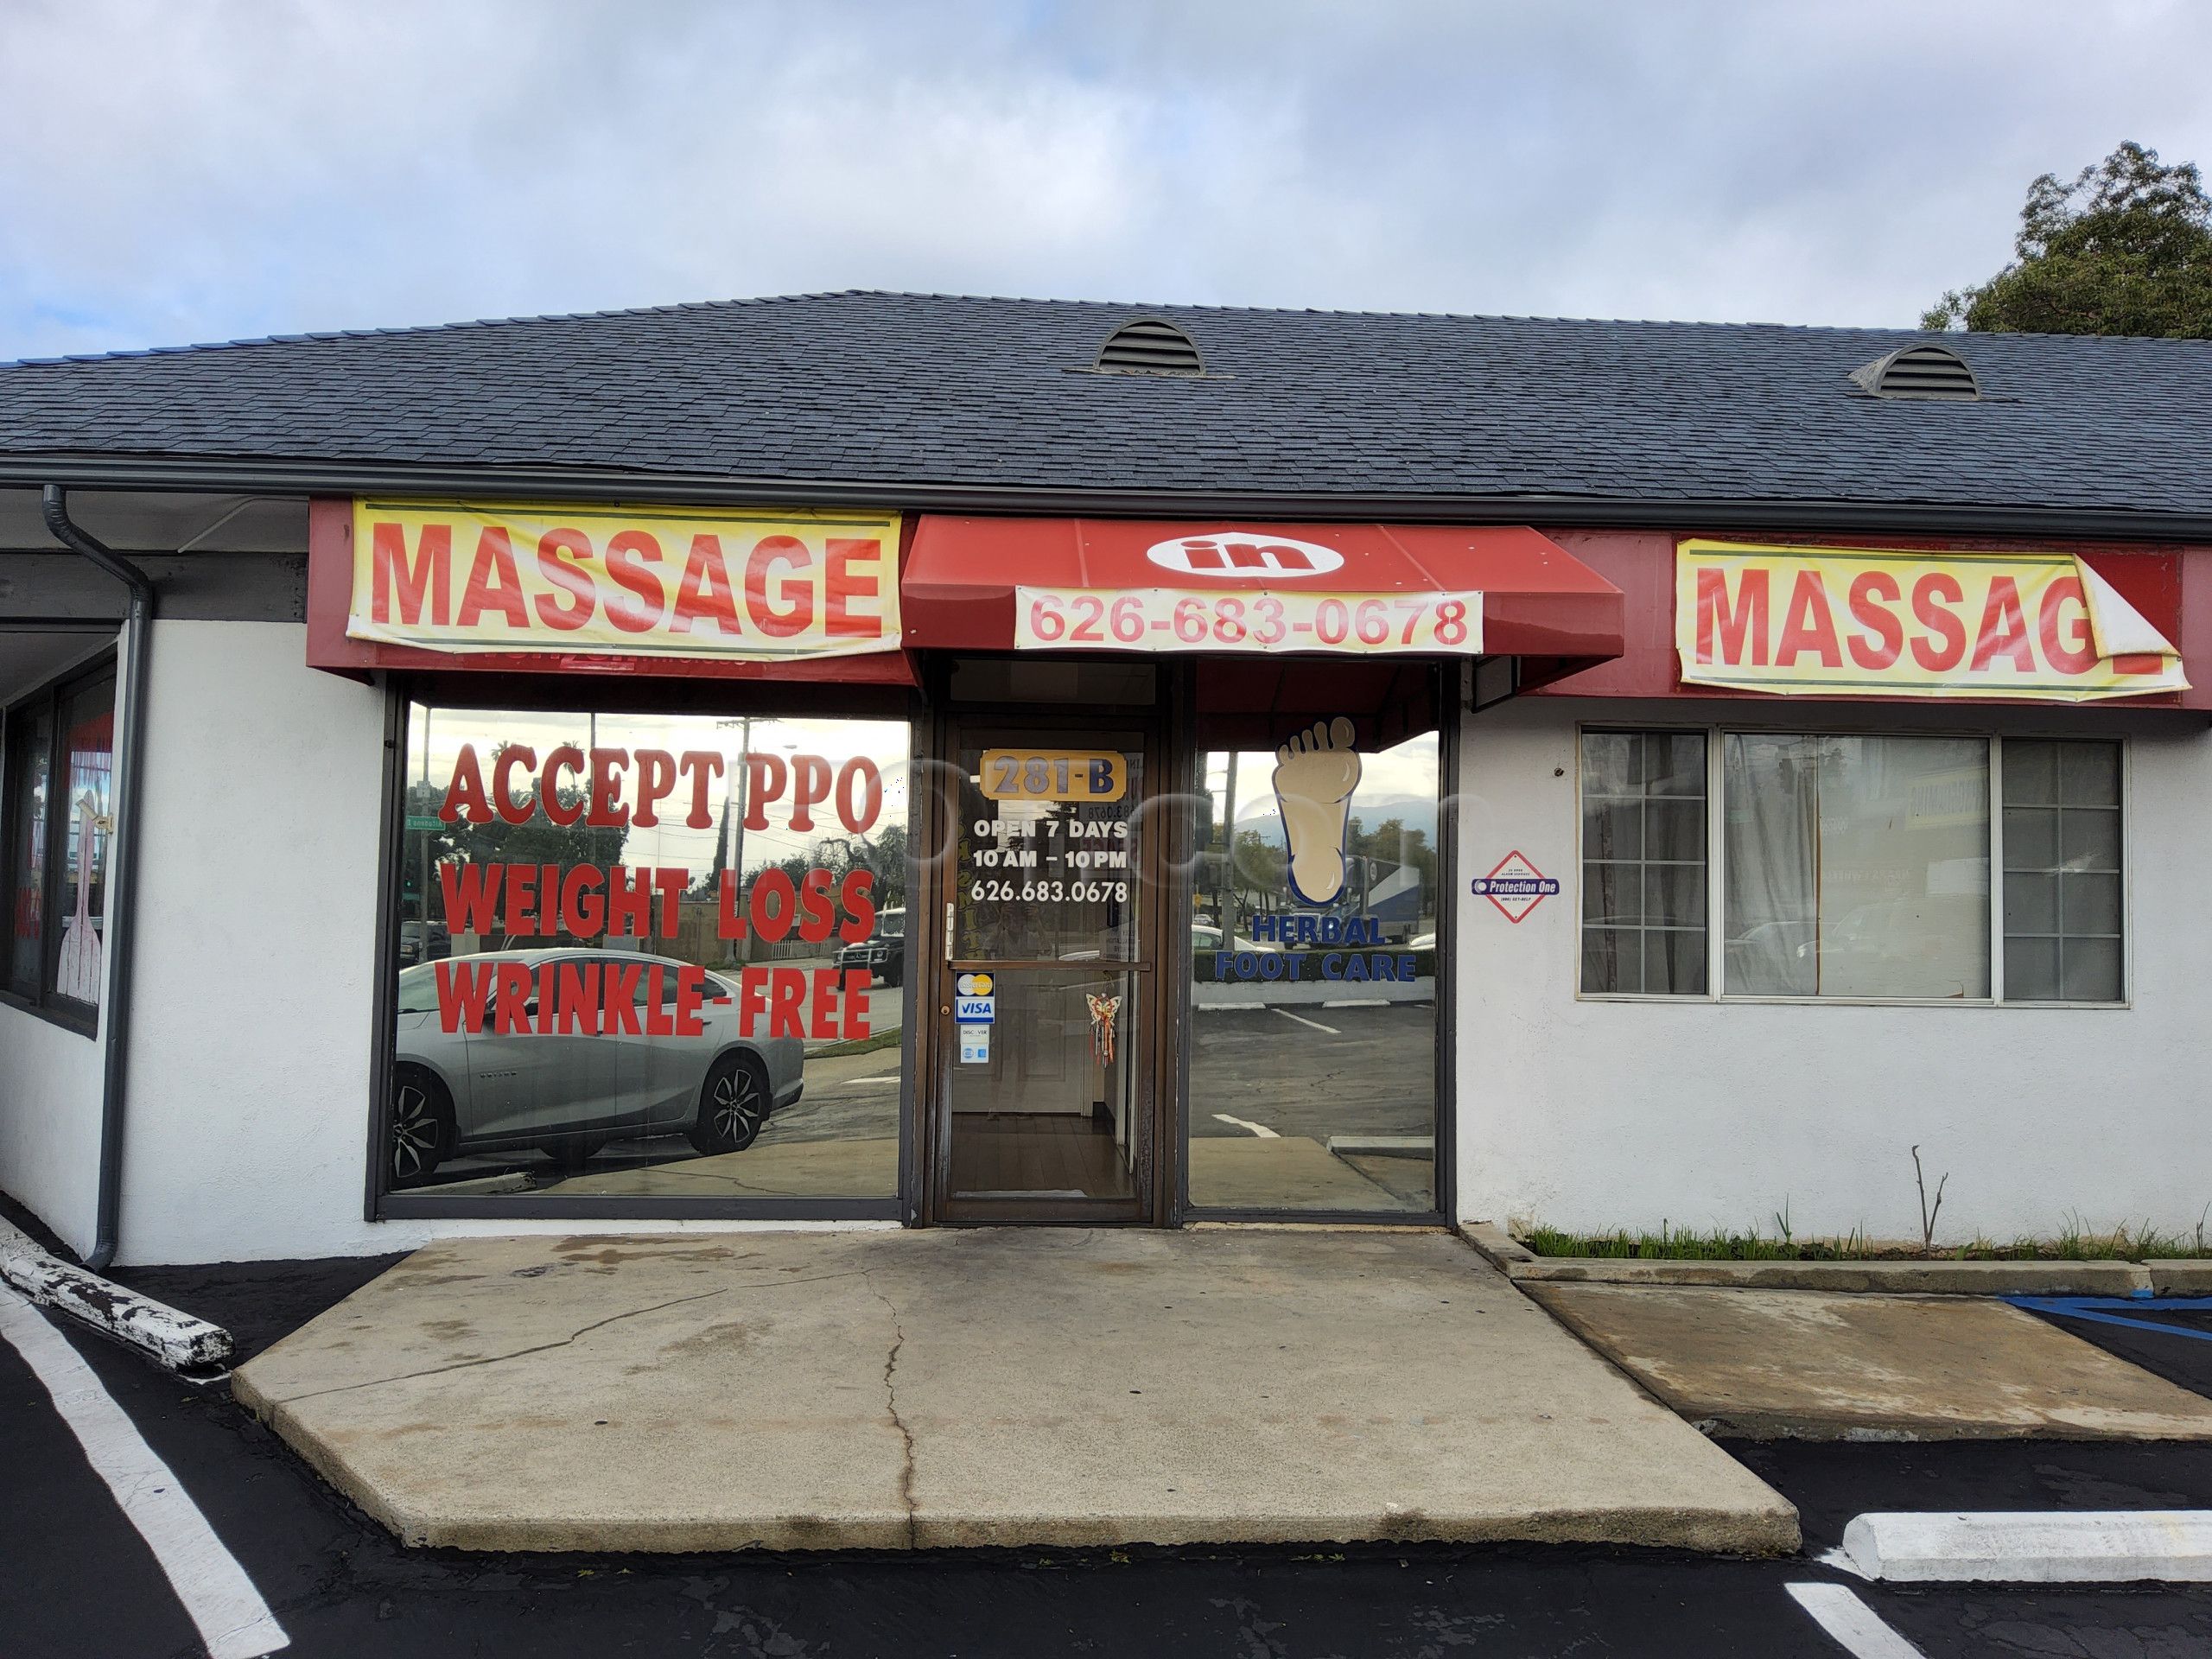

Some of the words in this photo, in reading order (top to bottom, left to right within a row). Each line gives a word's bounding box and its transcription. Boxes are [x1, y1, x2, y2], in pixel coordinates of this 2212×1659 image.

[1180, 540, 1315, 570] in
[372, 522, 882, 639] MASSAGE
[1030, 594, 1469, 647] 626-683-0678
[1696, 568, 2164, 676] MASSAG
[437, 743, 724, 830] ACCEPT
[743, 752, 883, 834] PPO
[993, 755, 1115, 794] 281-B
[974, 819, 1036, 837] OPEN
[1046, 821, 1059, 837] 7
[1070, 820, 1128, 838] DAYS
[973, 849, 998, 868] 10
[1002, 850, 1037, 868] AM
[1065, 851, 1090, 868] 10
[1094, 851, 1127, 868] PM
[971, 880, 1128, 903] 626.683.0678
[1490, 880, 1536, 893] Protection
[1538, 880, 1556, 893] One
[439, 862, 689, 939] WEIGHT
[718, 868, 876, 944] LOSS
[1253, 914, 1386, 944] HERBAL
[1215, 950, 1306, 981] FOOT
[1321, 953, 1417, 982] CARE
[962, 1002, 992, 1014] VISA
